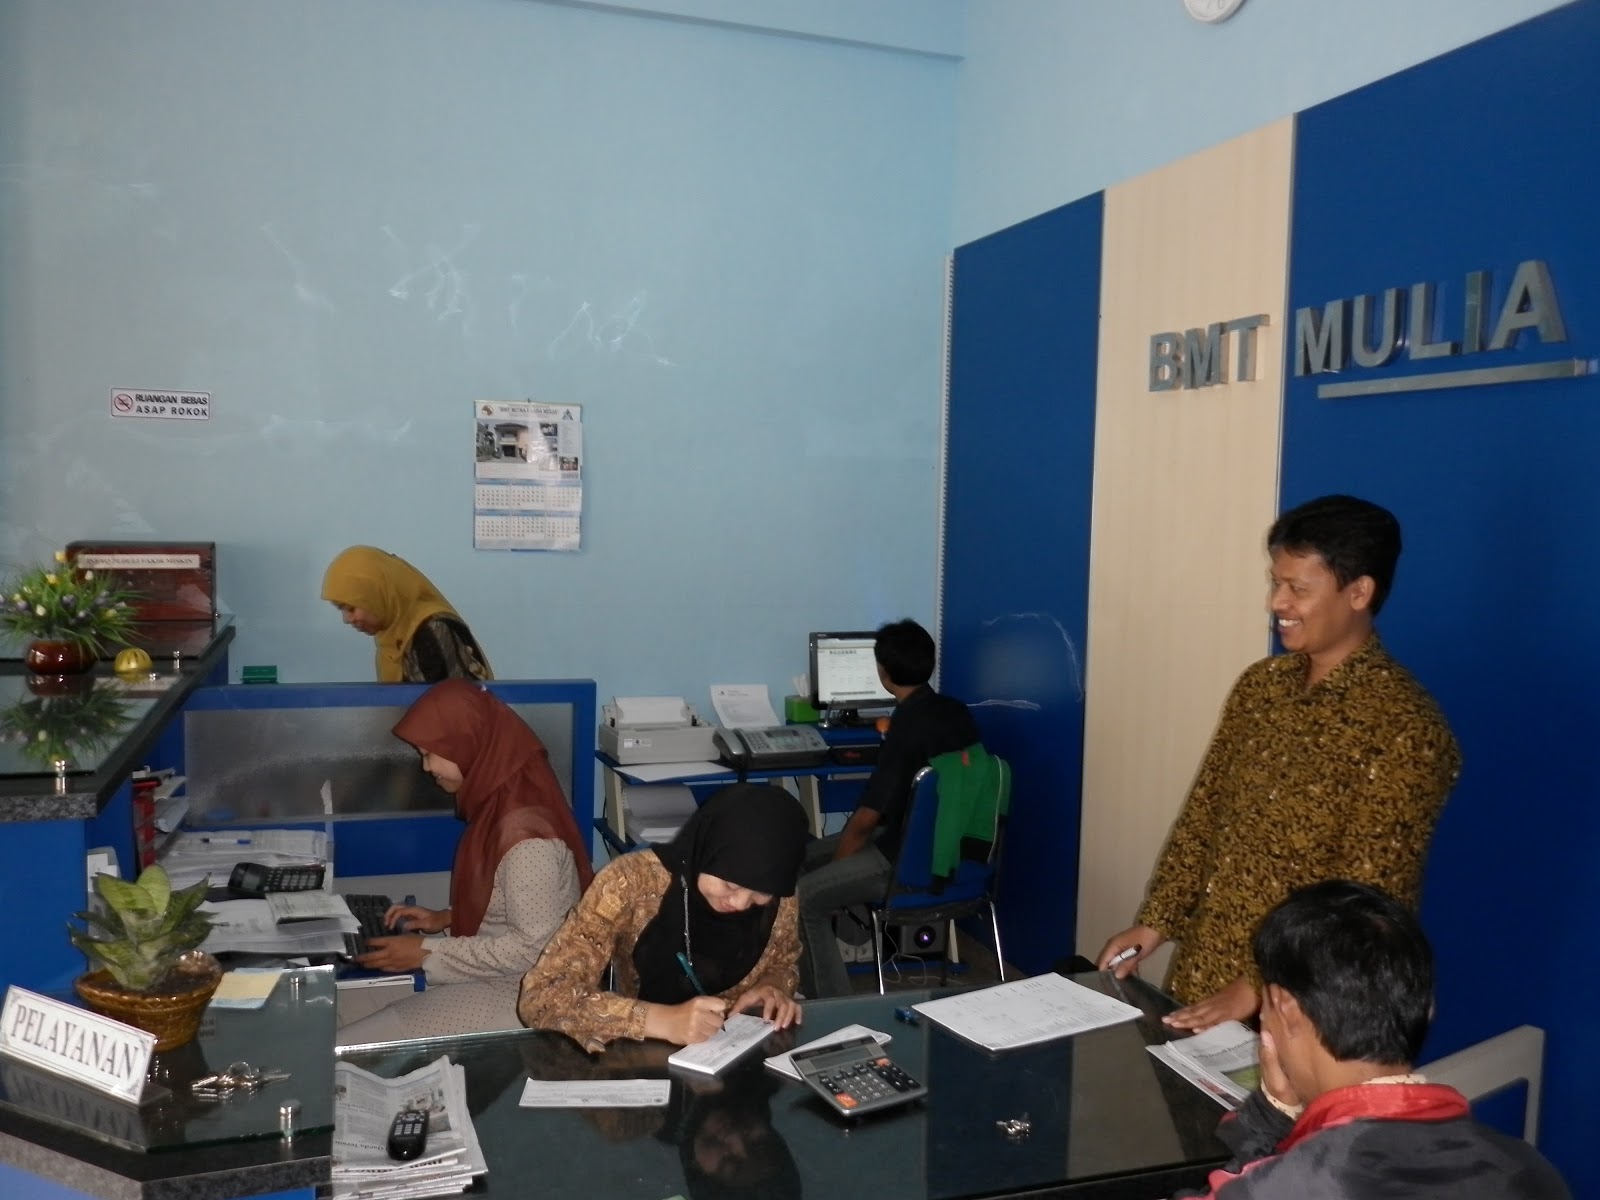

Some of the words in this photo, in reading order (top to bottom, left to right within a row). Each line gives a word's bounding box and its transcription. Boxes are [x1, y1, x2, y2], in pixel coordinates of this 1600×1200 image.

[1149, 314, 1270, 392] BMT
[1294, 259, 1567, 377] MULIA
[135, 393, 178, 404] RUANGAN
[180, 395, 208, 406] BEBAS
[135, 405, 166, 414] ASAP
[171, 406, 208, 416] ROKOK
[10, 1003, 139, 1080] PELAYANAN
